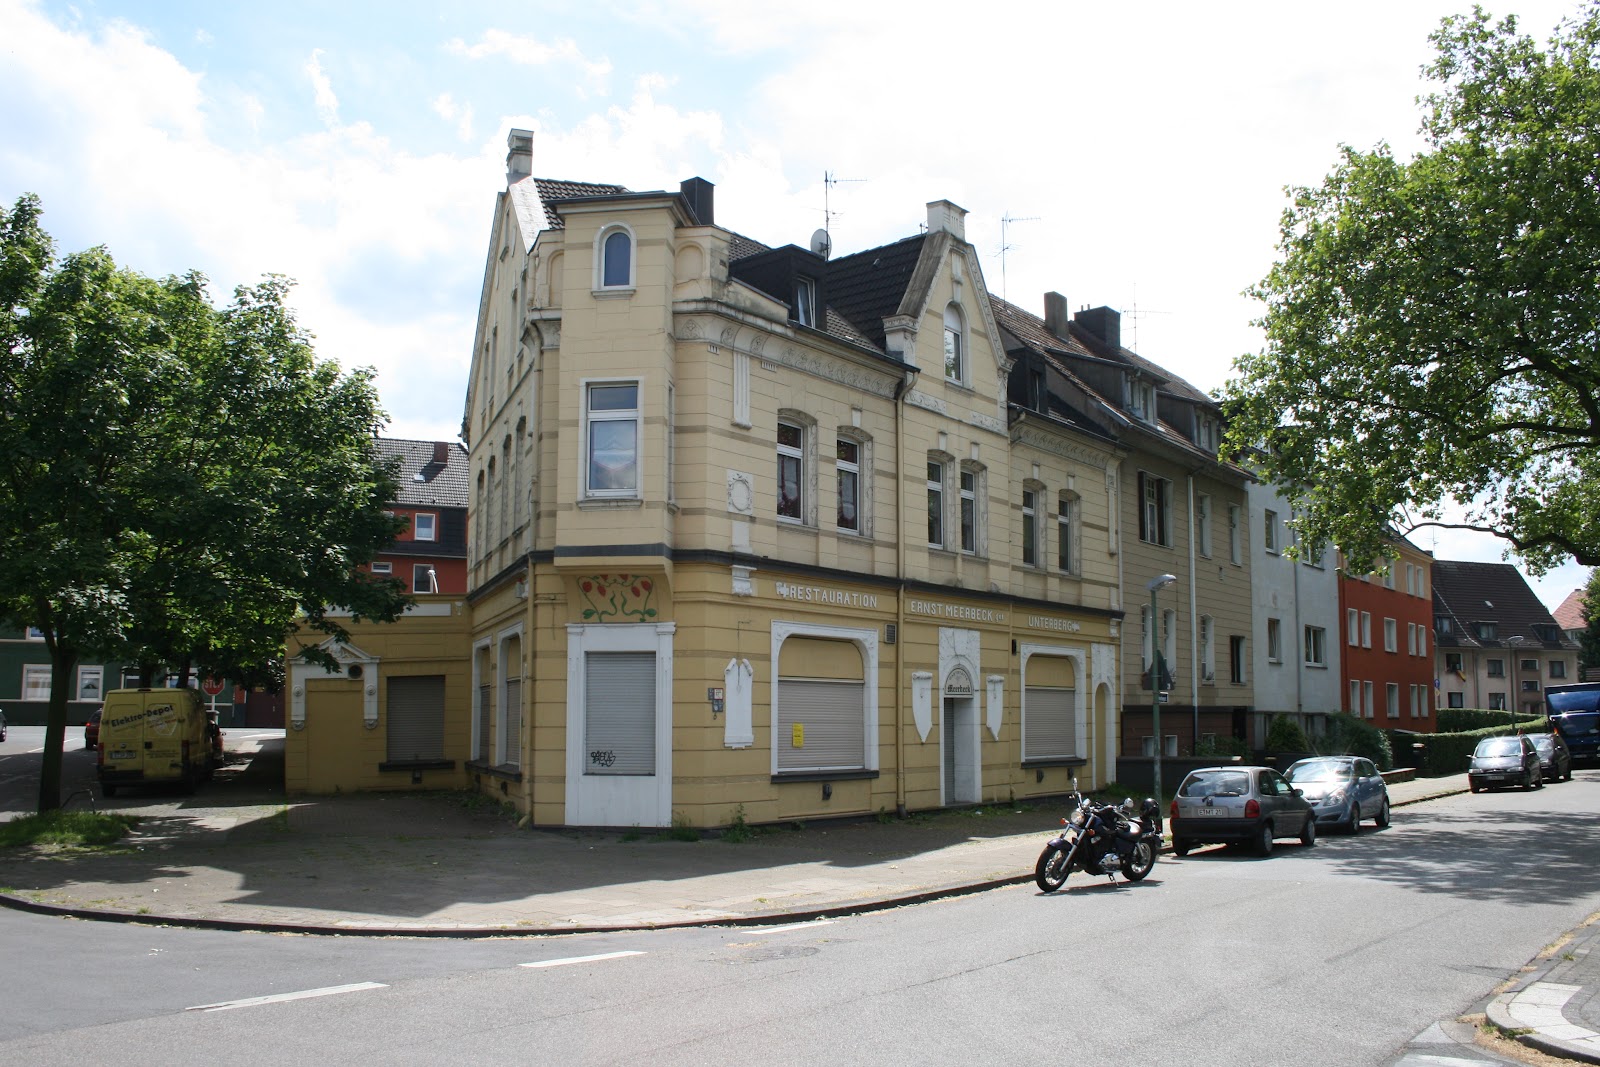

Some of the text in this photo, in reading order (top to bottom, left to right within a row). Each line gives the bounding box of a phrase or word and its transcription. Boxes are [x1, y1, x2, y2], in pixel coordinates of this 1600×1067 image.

[789, 585, 877, 608] RESTAURATION
[911, 601, 943, 615] ERNST
[945, 604, 993, 621] MEERBECK
[1028, 616, 1072, 631] UNTERBERG
[111, 705, 174, 727] Elektro-Depot
